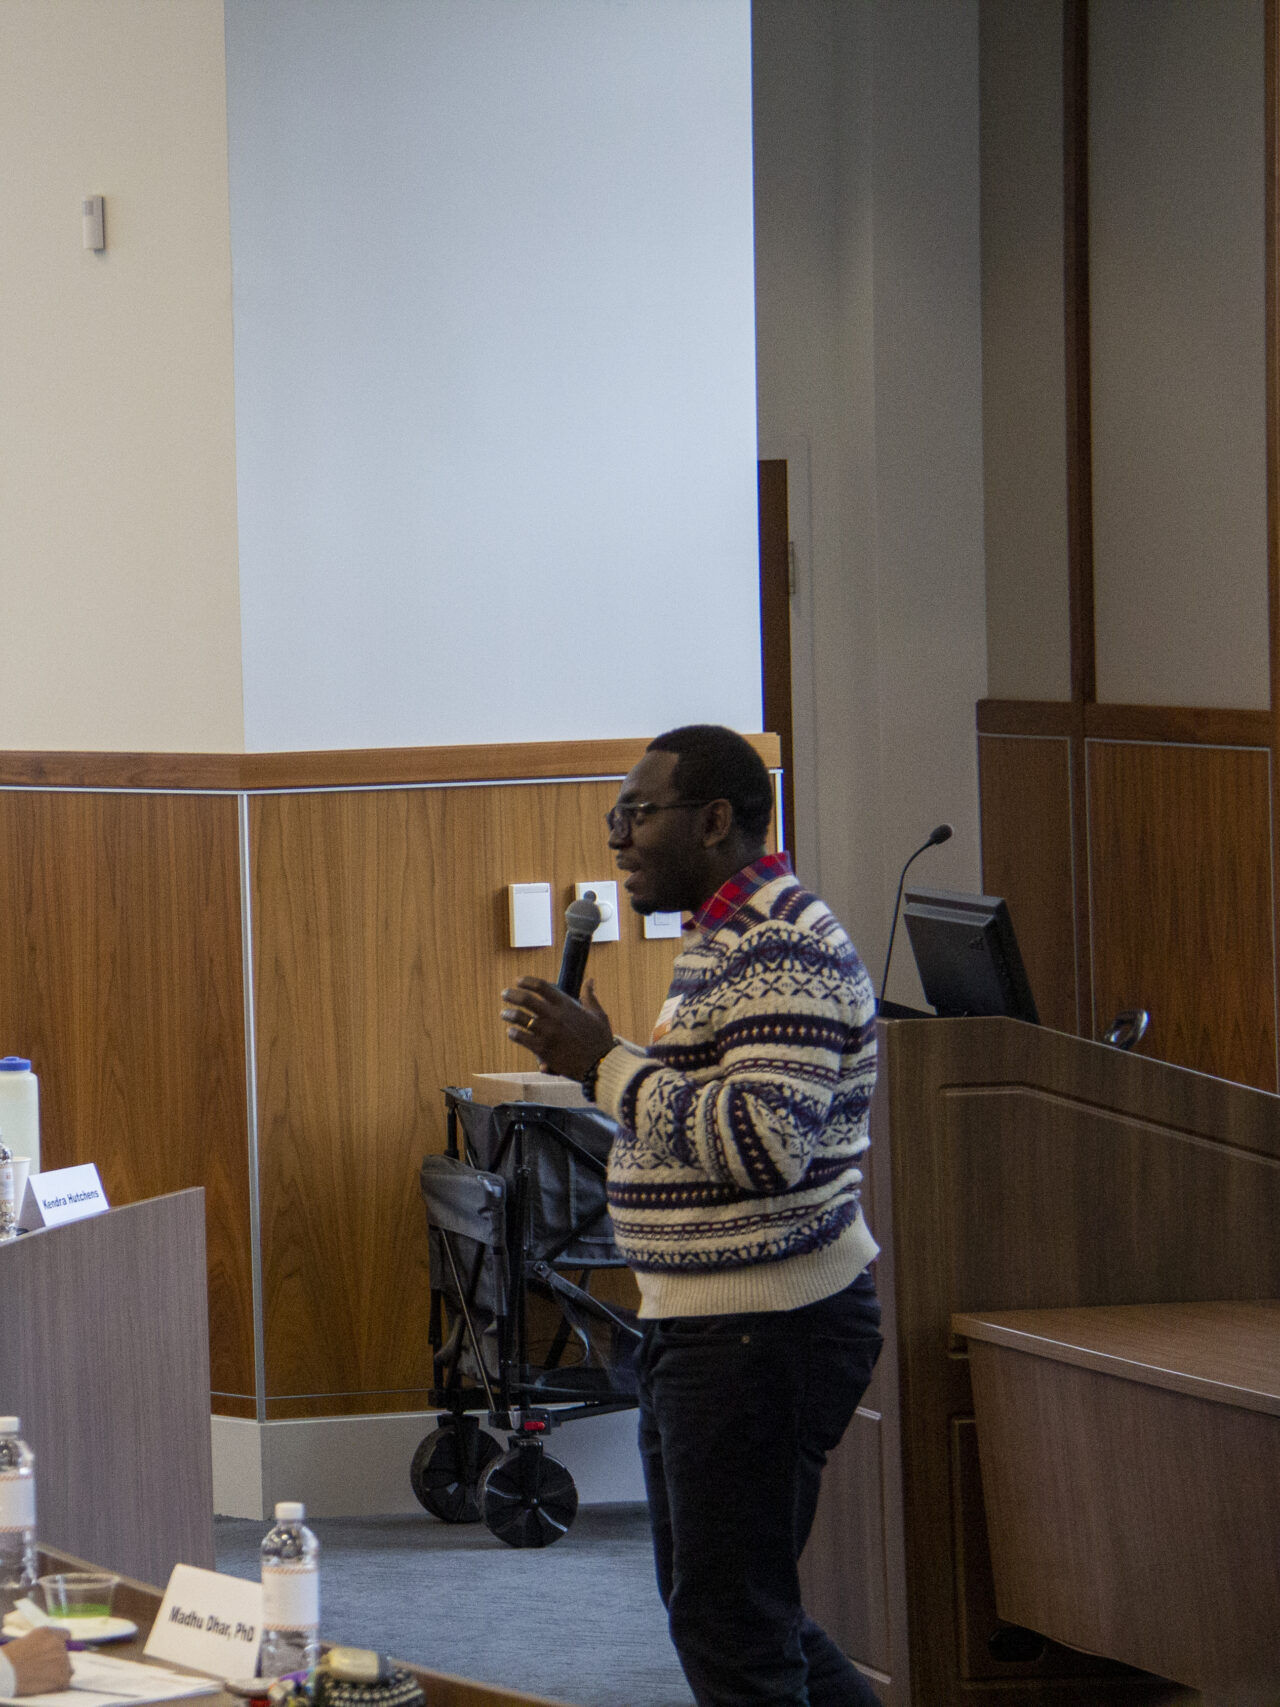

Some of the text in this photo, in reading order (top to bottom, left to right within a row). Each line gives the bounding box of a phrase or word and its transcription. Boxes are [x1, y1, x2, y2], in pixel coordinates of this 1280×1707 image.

[42, 1189, 99, 1210] Kendra Hutchens
[169, 1605, 255, 1642] Madhu Dhar, PhD
